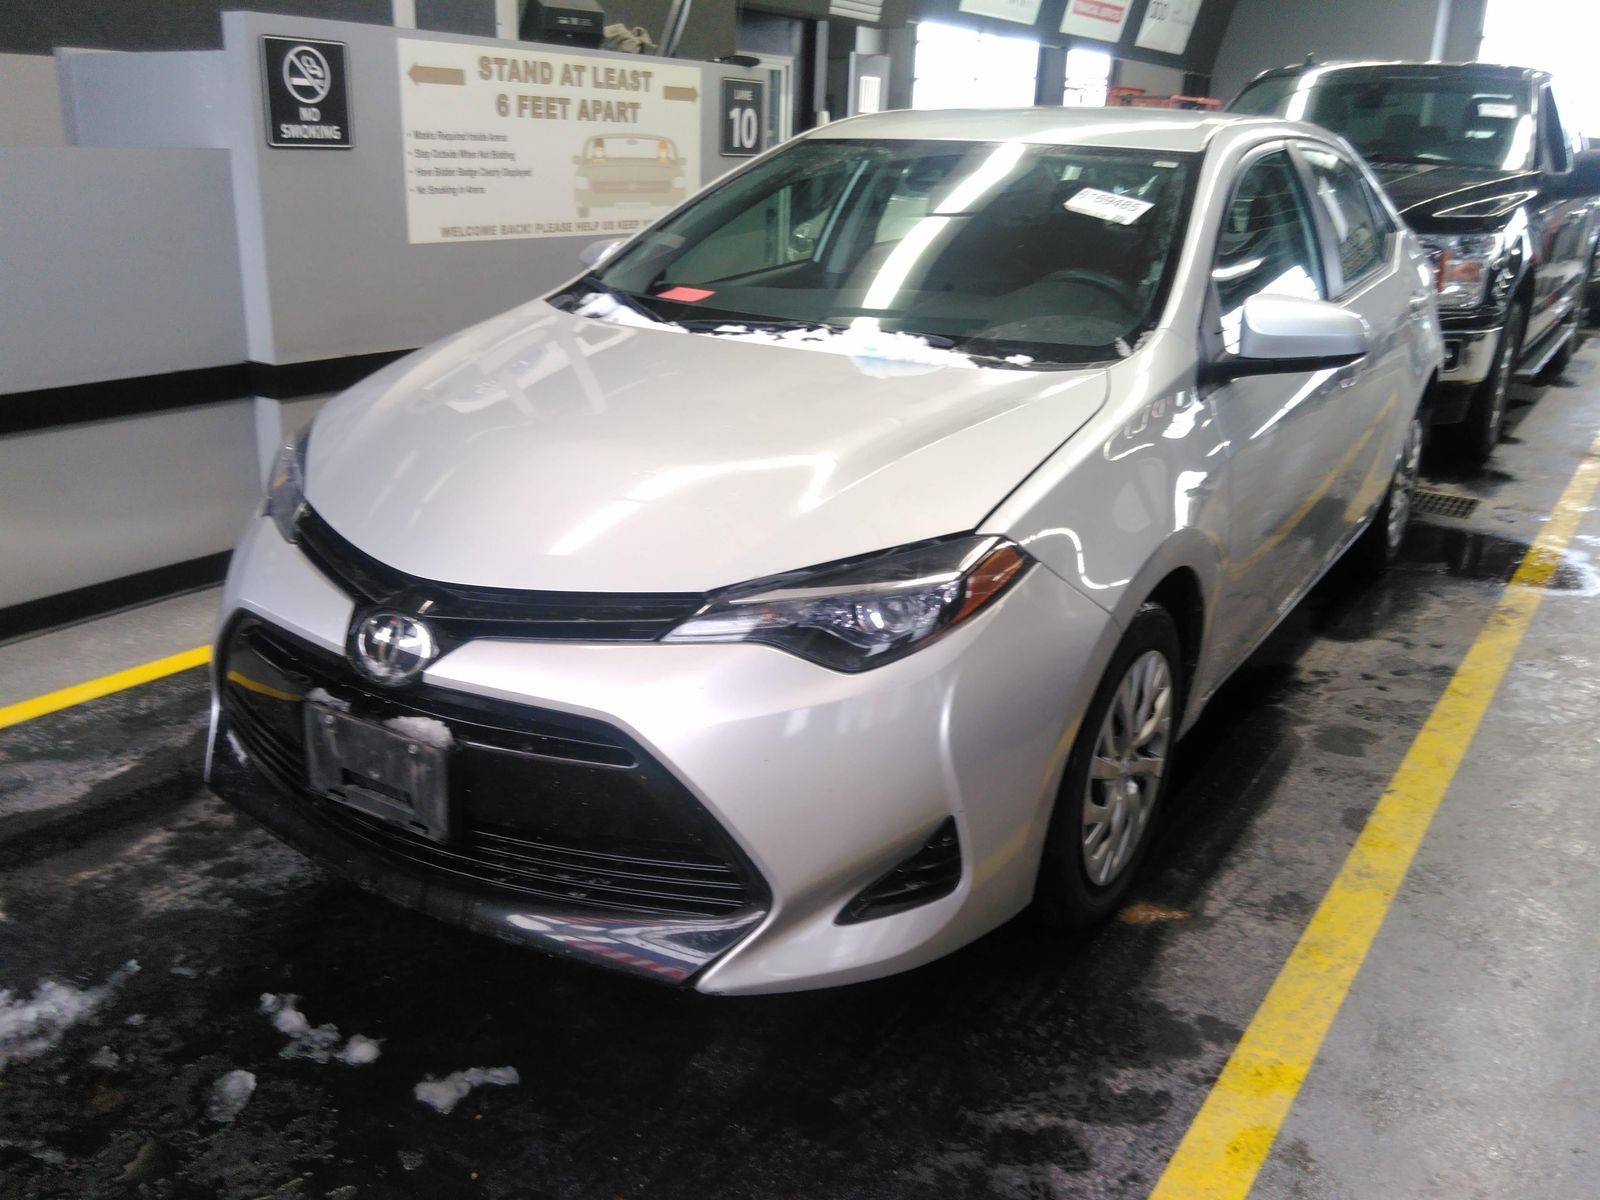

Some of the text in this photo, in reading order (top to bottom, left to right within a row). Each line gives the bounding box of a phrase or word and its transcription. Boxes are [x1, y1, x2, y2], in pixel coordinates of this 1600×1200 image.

[478, 55, 653, 92] STAND AT LEAST
[734, 89, 753, 100] LANE
[298, 107, 321, 122] NO
[496, 93, 641, 123] 6 FEET APART
[280, 123, 342, 140] SMOKING
[729, 107, 758, 149] 10
[440, 225, 497, 238] WELCOME
[501, 224, 531, 235] BACK!
[535, 222, 573, 234] PLEASE
[576, 221, 599, 232] HELP
[602, 220, 614, 230] US
[618, 219, 640, 230] KEEP
